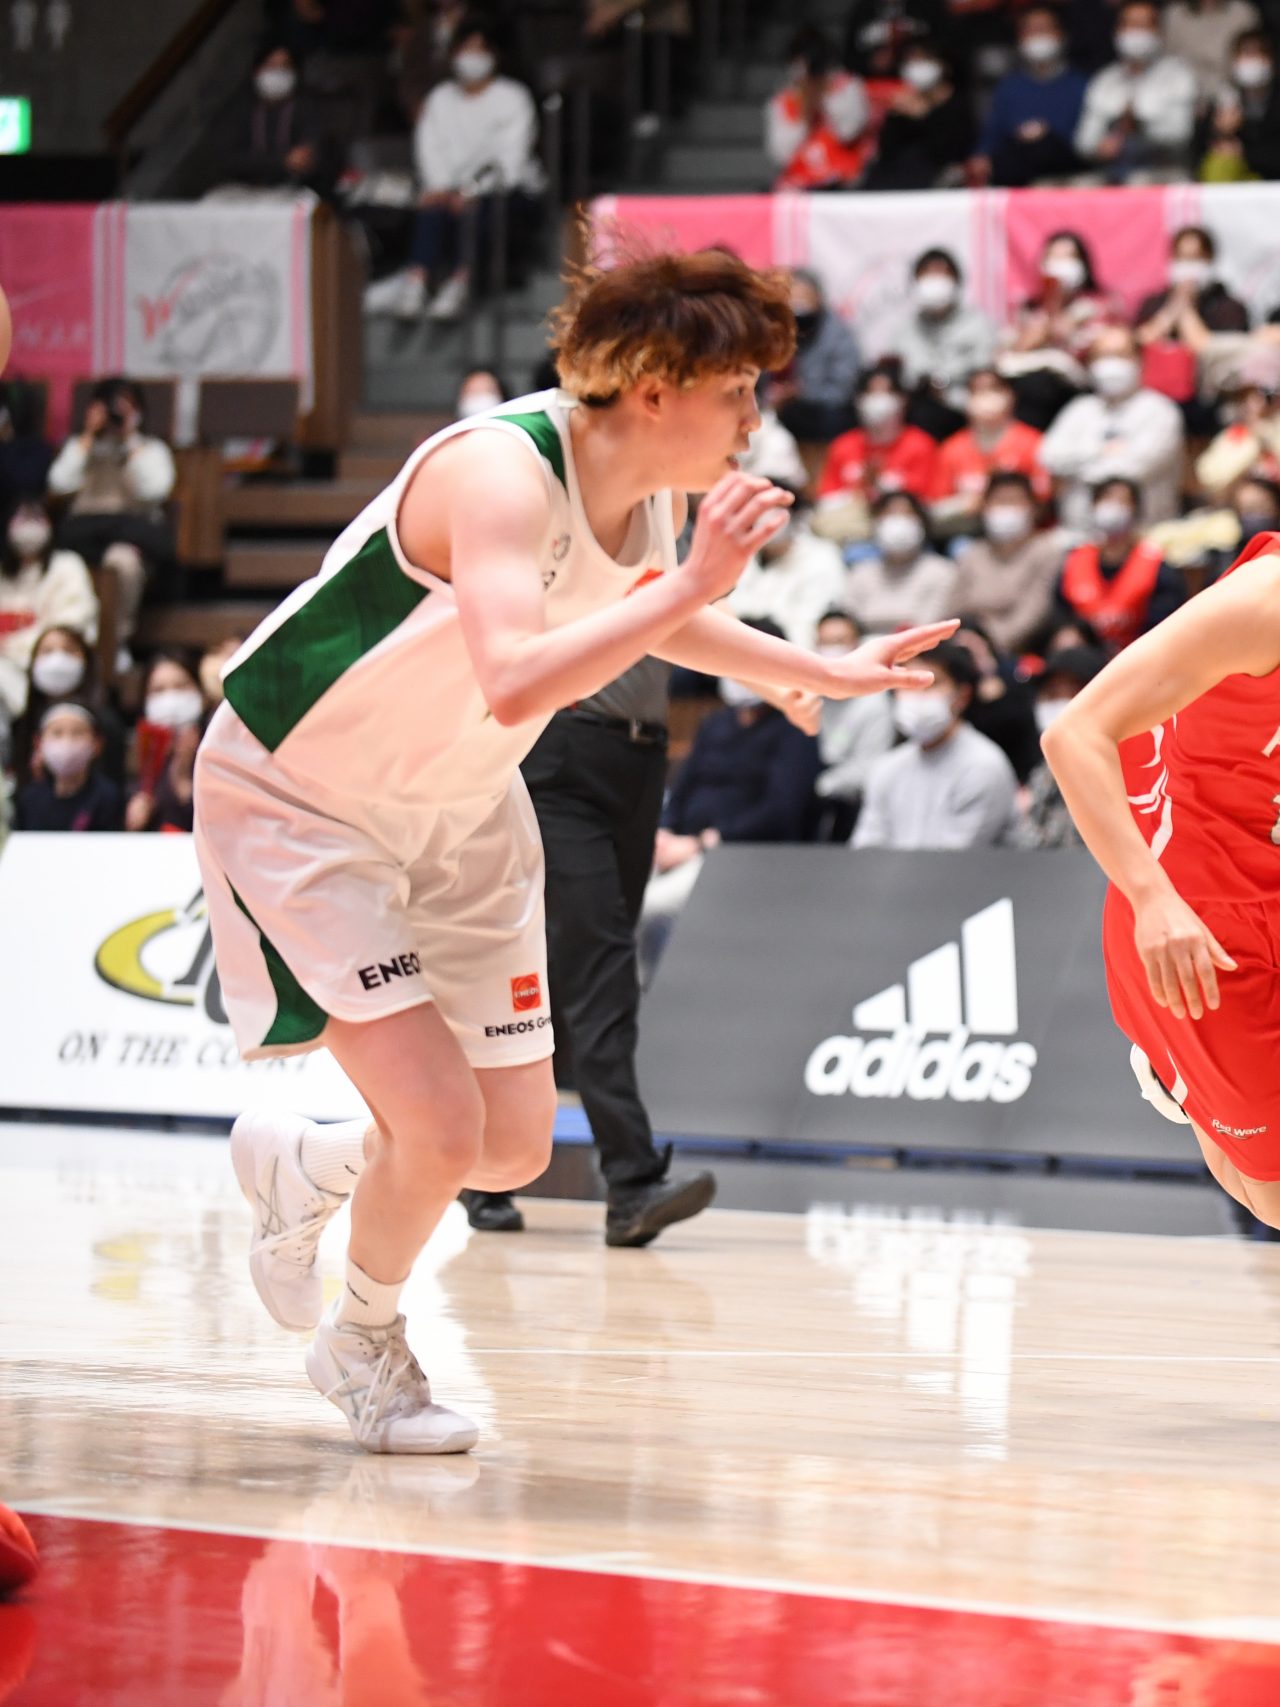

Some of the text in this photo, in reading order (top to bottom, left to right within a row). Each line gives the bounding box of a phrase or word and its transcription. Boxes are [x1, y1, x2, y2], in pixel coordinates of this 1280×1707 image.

[358, 952, 422, 991] ENEO
[484, 1020, 535, 1038] ENEOS
[58, 1030, 108, 1064] ON
[116, 1031, 188, 1067] THE
[804, 1022, 1038, 1103] adidas
[1233, 1126, 1268, 1137] Wave
